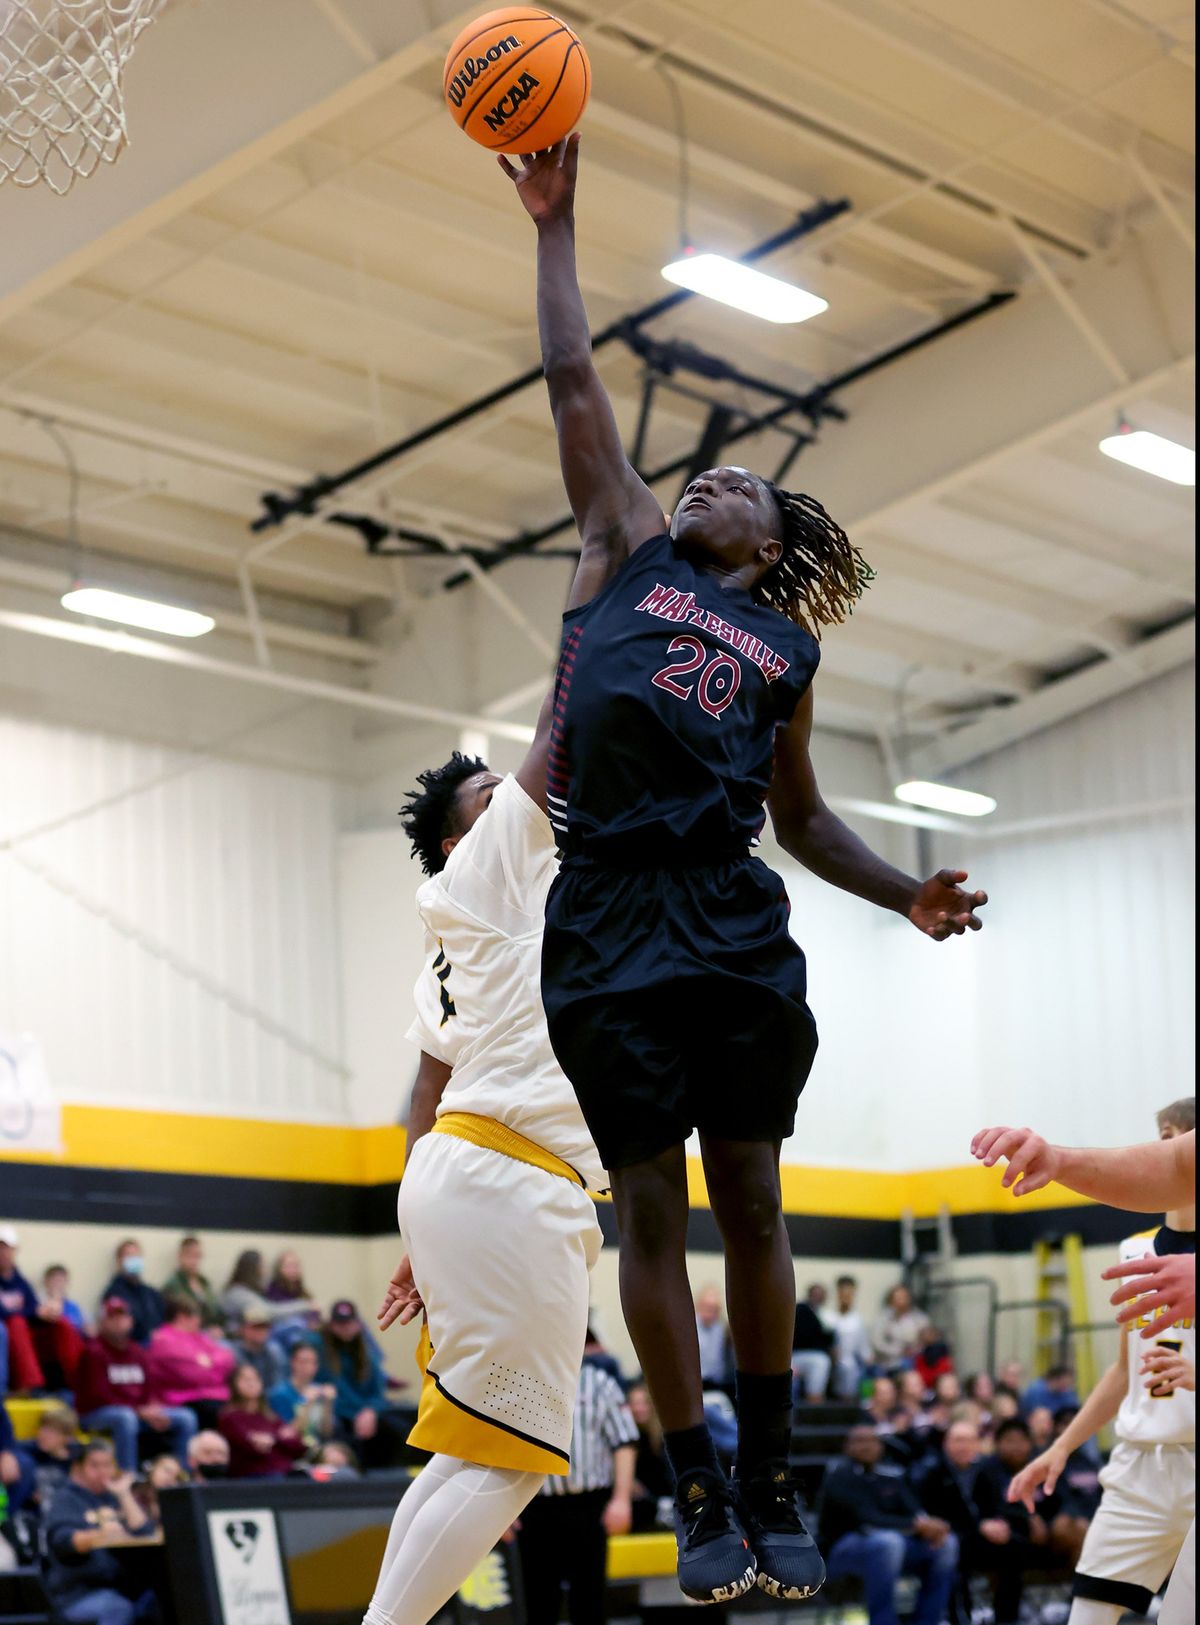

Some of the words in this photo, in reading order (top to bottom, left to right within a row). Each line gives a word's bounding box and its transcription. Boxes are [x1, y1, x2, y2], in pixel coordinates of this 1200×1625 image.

[447, 35, 521, 108] Wilson
[483, 72, 540, 132] NCAA
[651, 635, 742, 721] 20
